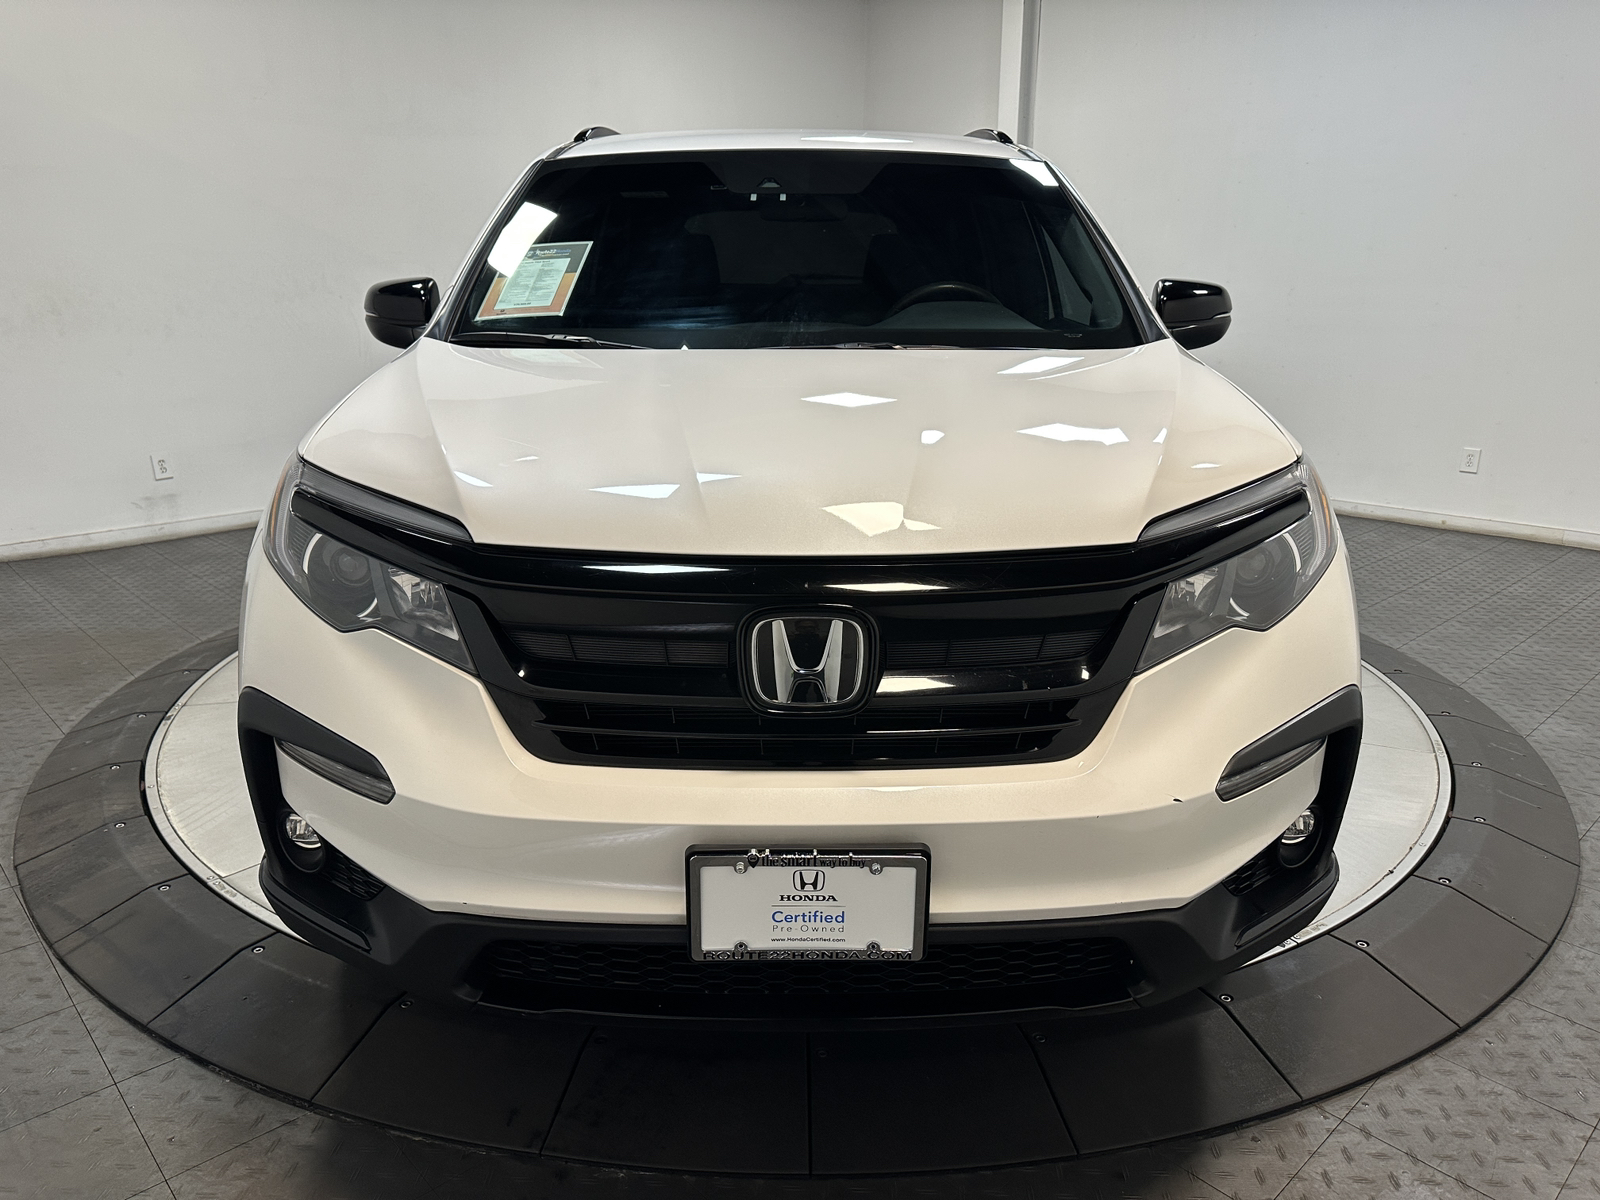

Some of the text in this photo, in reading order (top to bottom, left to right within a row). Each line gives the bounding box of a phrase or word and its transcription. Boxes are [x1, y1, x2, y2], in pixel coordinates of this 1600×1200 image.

[761, 853, 867, 869] the smart way to buy
[779, 894, 838, 902] HONDA
[771, 910, 845, 924] Certified
[772, 924, 845, 933] Pre-Owned
[702, 951, 912, 961] ROUTE22HONDA.COM
